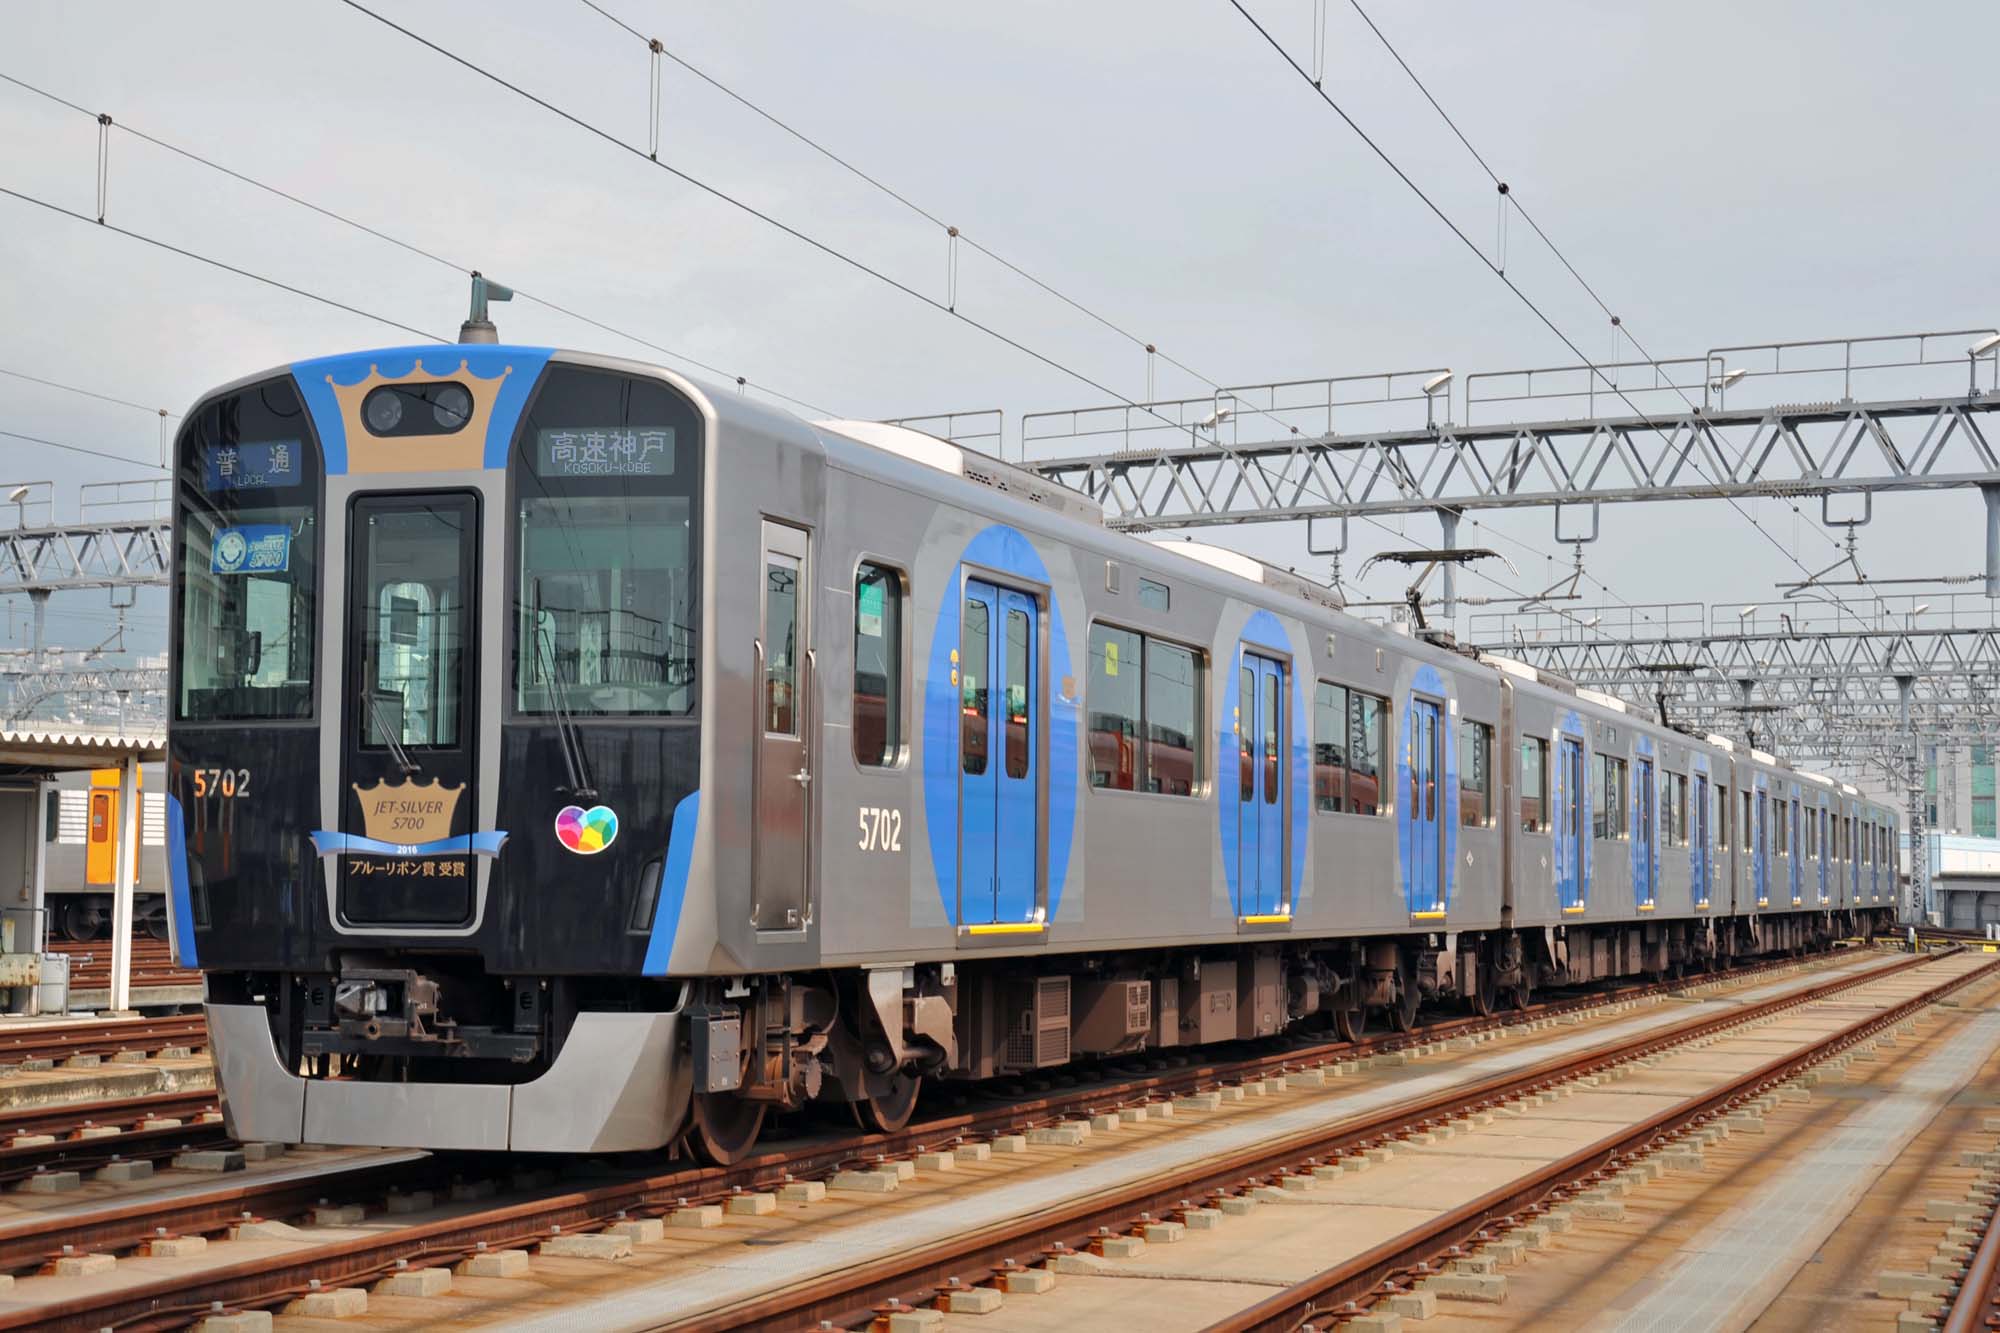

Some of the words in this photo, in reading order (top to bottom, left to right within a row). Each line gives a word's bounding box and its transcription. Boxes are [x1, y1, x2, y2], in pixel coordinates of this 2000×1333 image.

[549, 430, 667, 463] 高速神戸
[564, 462, 652, 473] KOSOKU-KOBE
[194, 768, 251, 797] 5702
[374, 801, 443, 816] JET-SILVER
[392, 817, 424, 830] 5700
[858, 807, 901, 852] 5702
[397, 845, 418, 854] 2016
